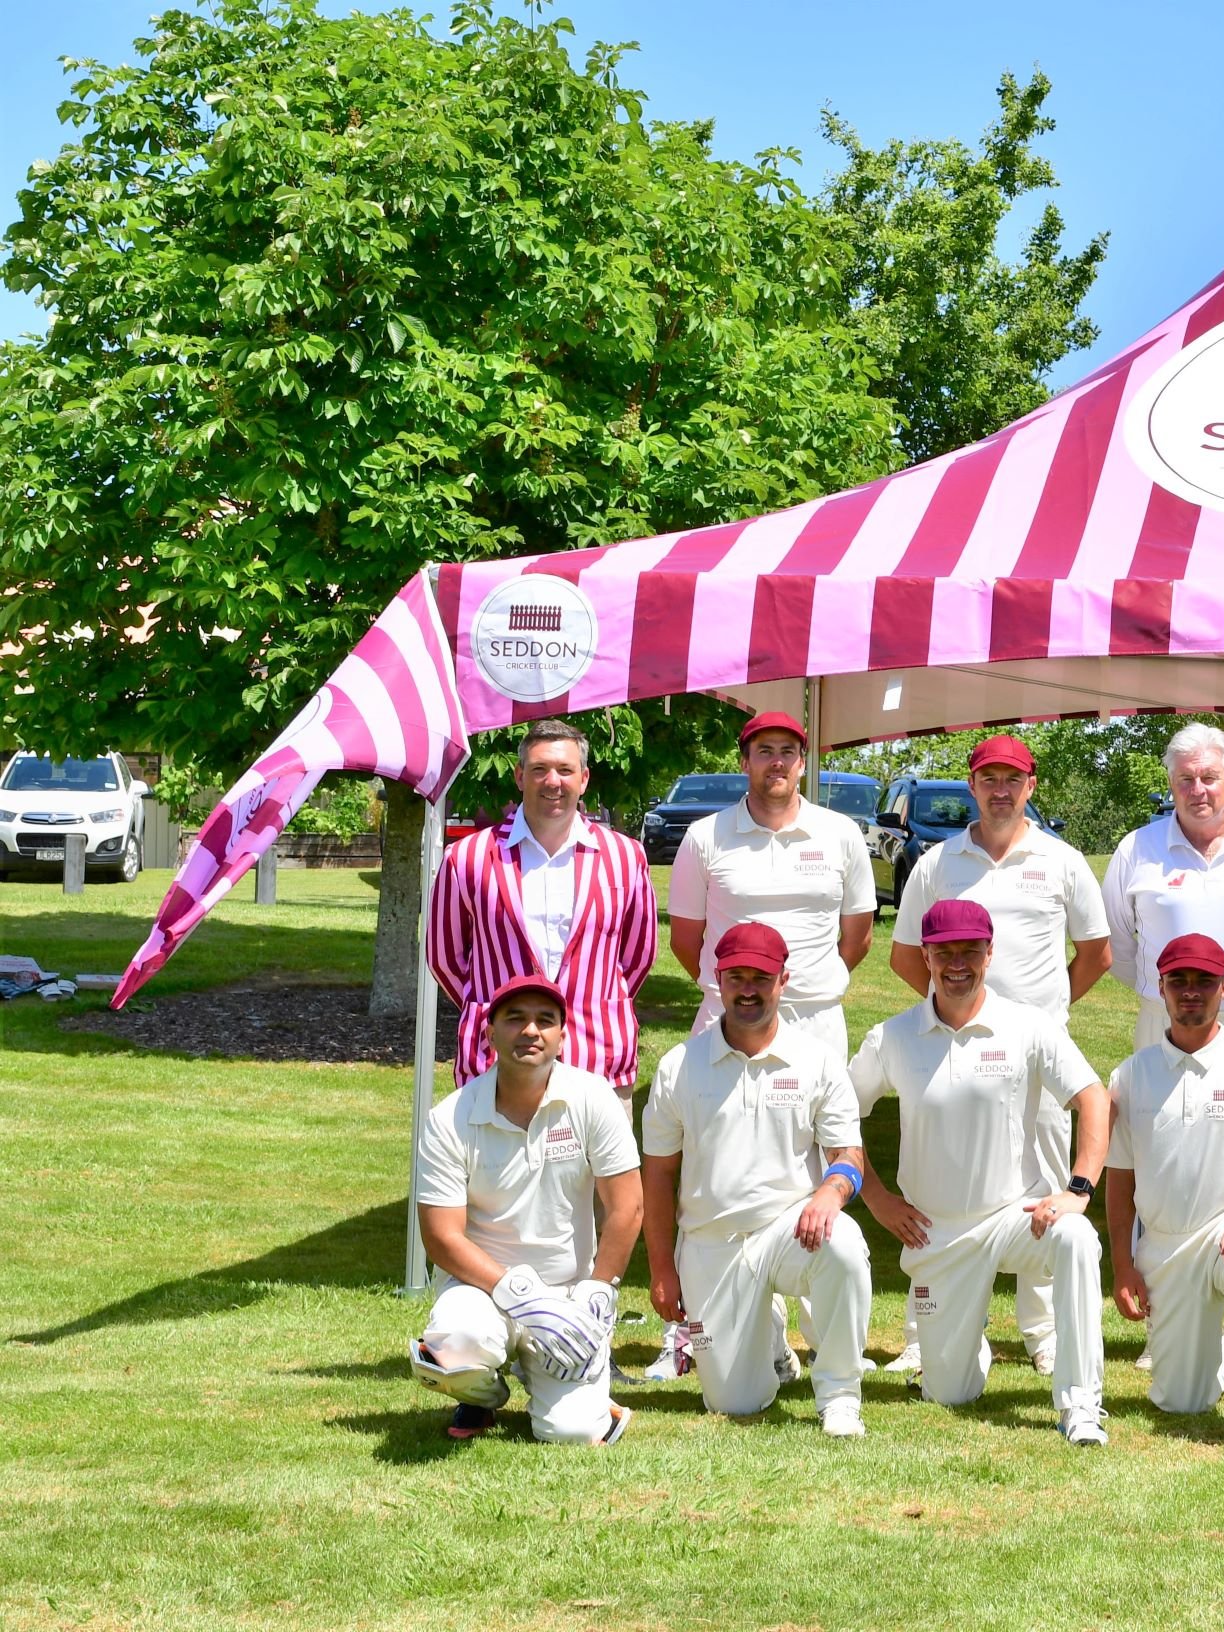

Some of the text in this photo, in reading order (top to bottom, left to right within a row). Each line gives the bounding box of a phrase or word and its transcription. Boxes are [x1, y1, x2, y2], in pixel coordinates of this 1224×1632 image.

[490, 640, 577, 658] SEDDON
[505, 662, 559, 670] CRICKET CLUB
[793, 864, 830, 872] SEDDON
[974, 1064, 1013, 1073] SEDDON
[766, 1093, 804, 1103] SEDDON
[545, 1143, 582, 1157] EDDON
